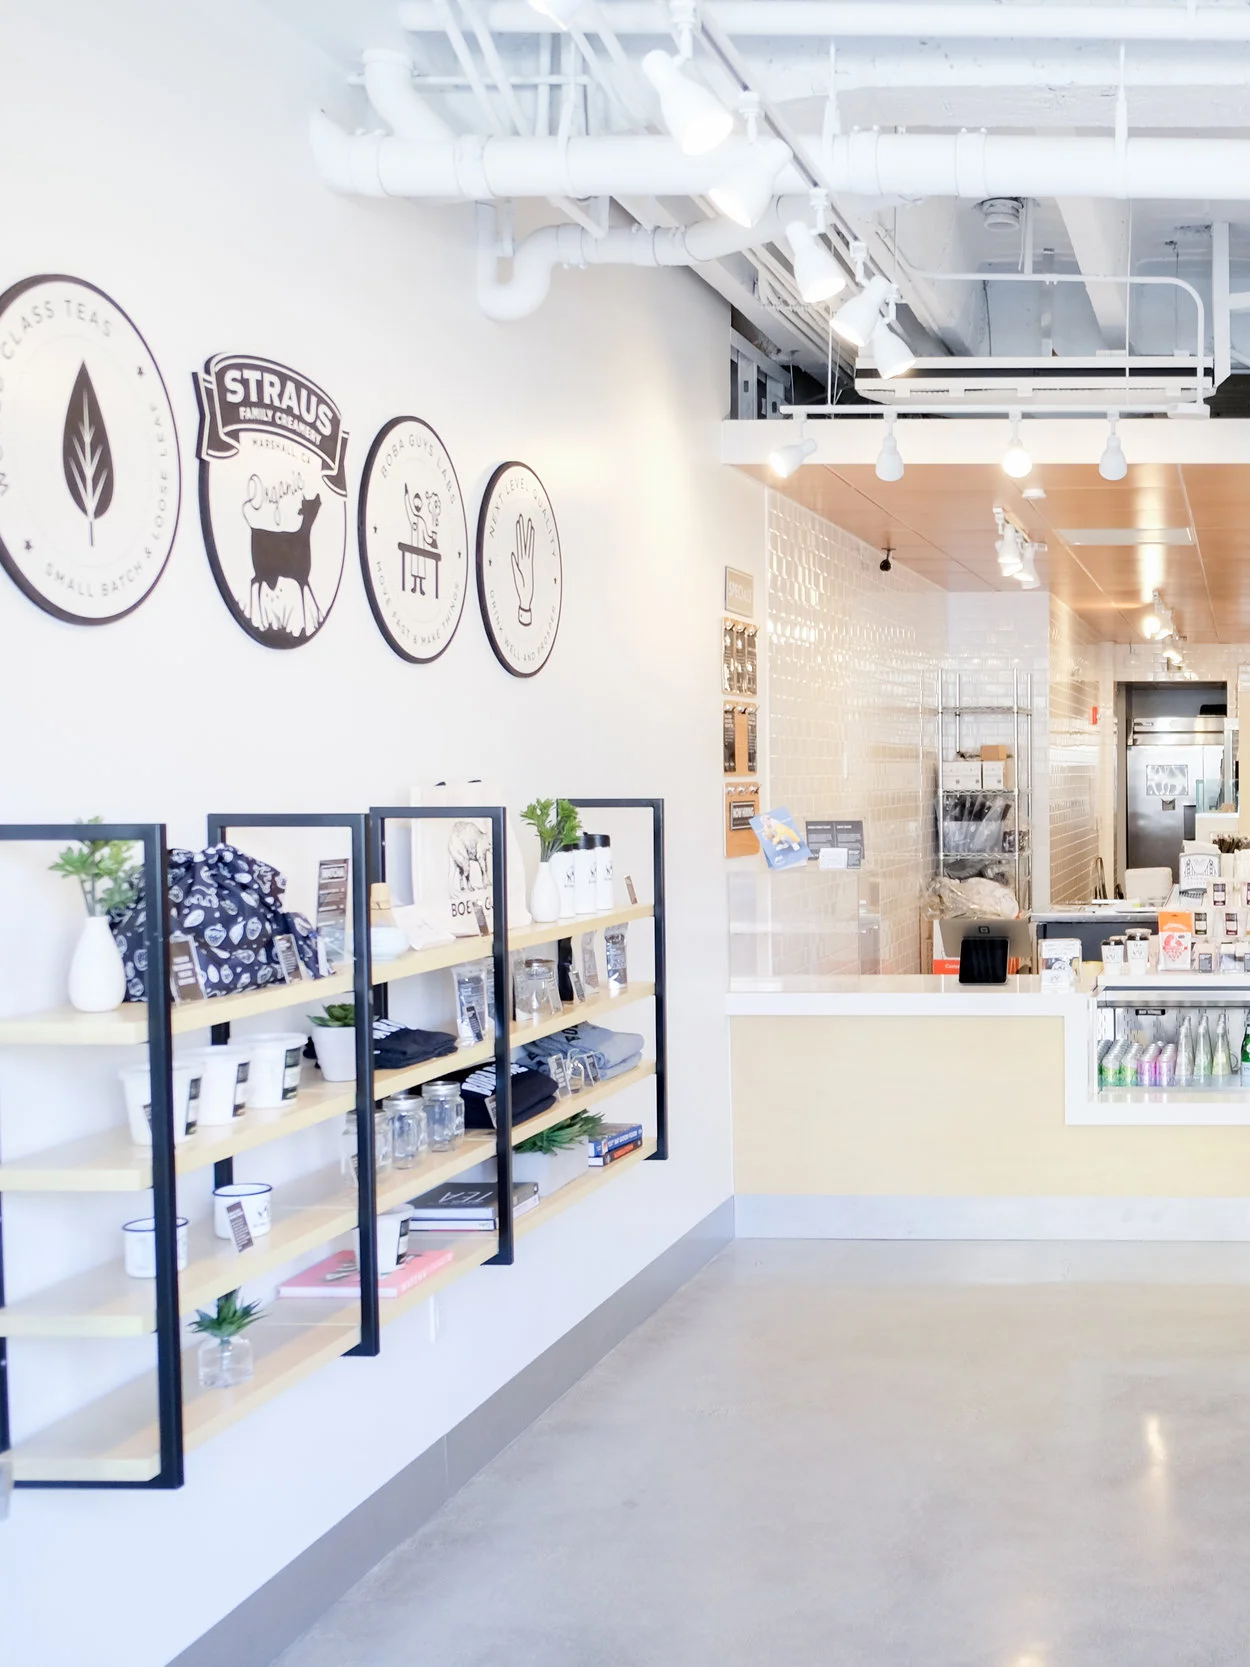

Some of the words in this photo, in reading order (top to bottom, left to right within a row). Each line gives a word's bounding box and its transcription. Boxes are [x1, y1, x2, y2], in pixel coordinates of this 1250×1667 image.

[0, 300, 54, 360] CLASS
[64, 299, 112, 338] TEAS
[223, 368, 334, 436] STRAUS
[238, 406, 274, 422] FAMILY
[274, 412, 322, 445] CREAMERY
[380, 439, 405, 479] BOBA
[408, 434, 434, 456] GUYS
[248, 470, 305, 527] Organic
[490, 492, 504, 538] NEXT
[506, 478, 529, 495] LEVEL
[533, 488, 556, 557] QUALITY
[44, 562, 94, 598] SMALL
[101, 560, 144, 597] BATCH
[152, 470, 169, 541] LOOSE
[392, 611, 410, 638] FAST
[420, 629, 440, 644] MAKE
[442, 583, 459, 629] THINGS
[504, 639, 520, 661] WELL
[523, 651, 535, 662] AND
[537, 604, 556, 655] PROSPER
